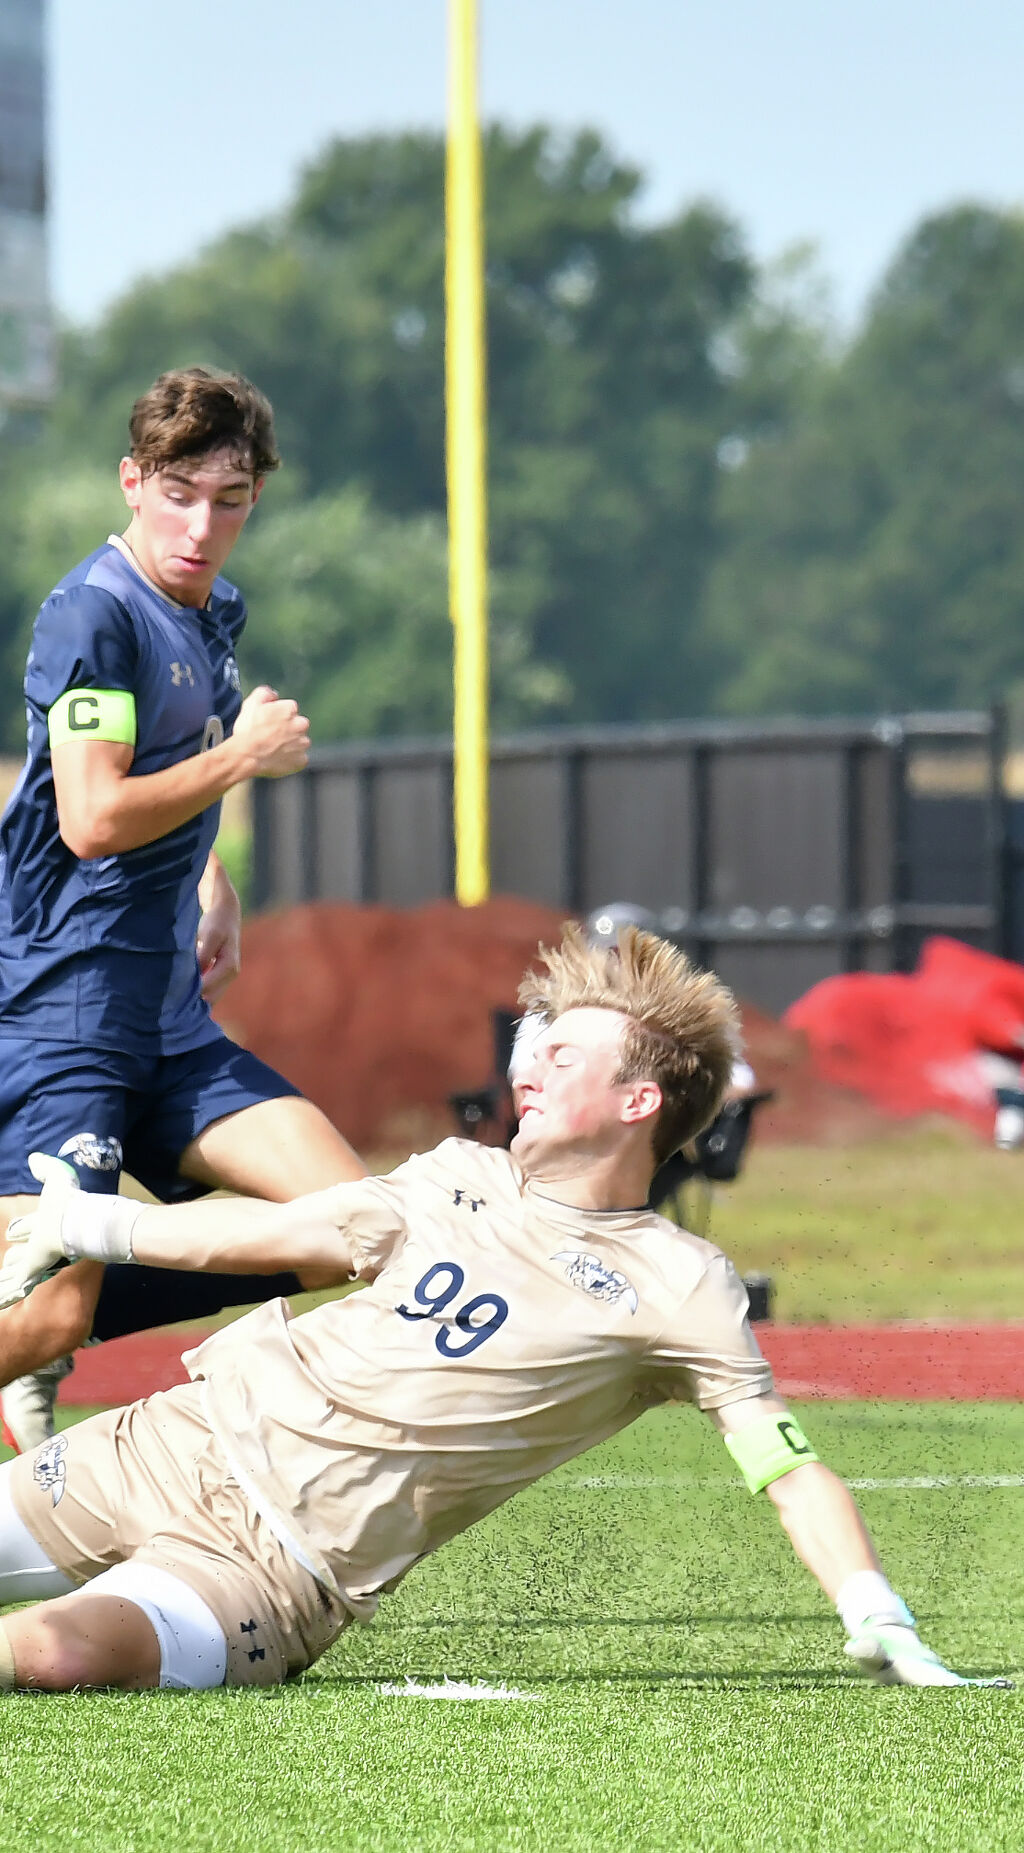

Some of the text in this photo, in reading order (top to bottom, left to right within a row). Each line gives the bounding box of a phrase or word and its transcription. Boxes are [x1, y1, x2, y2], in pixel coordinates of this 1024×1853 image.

[68, 697, 100, 730] C
[394, 1261, 509, 1358] 99
[777, 1421, 811, 1454] C
